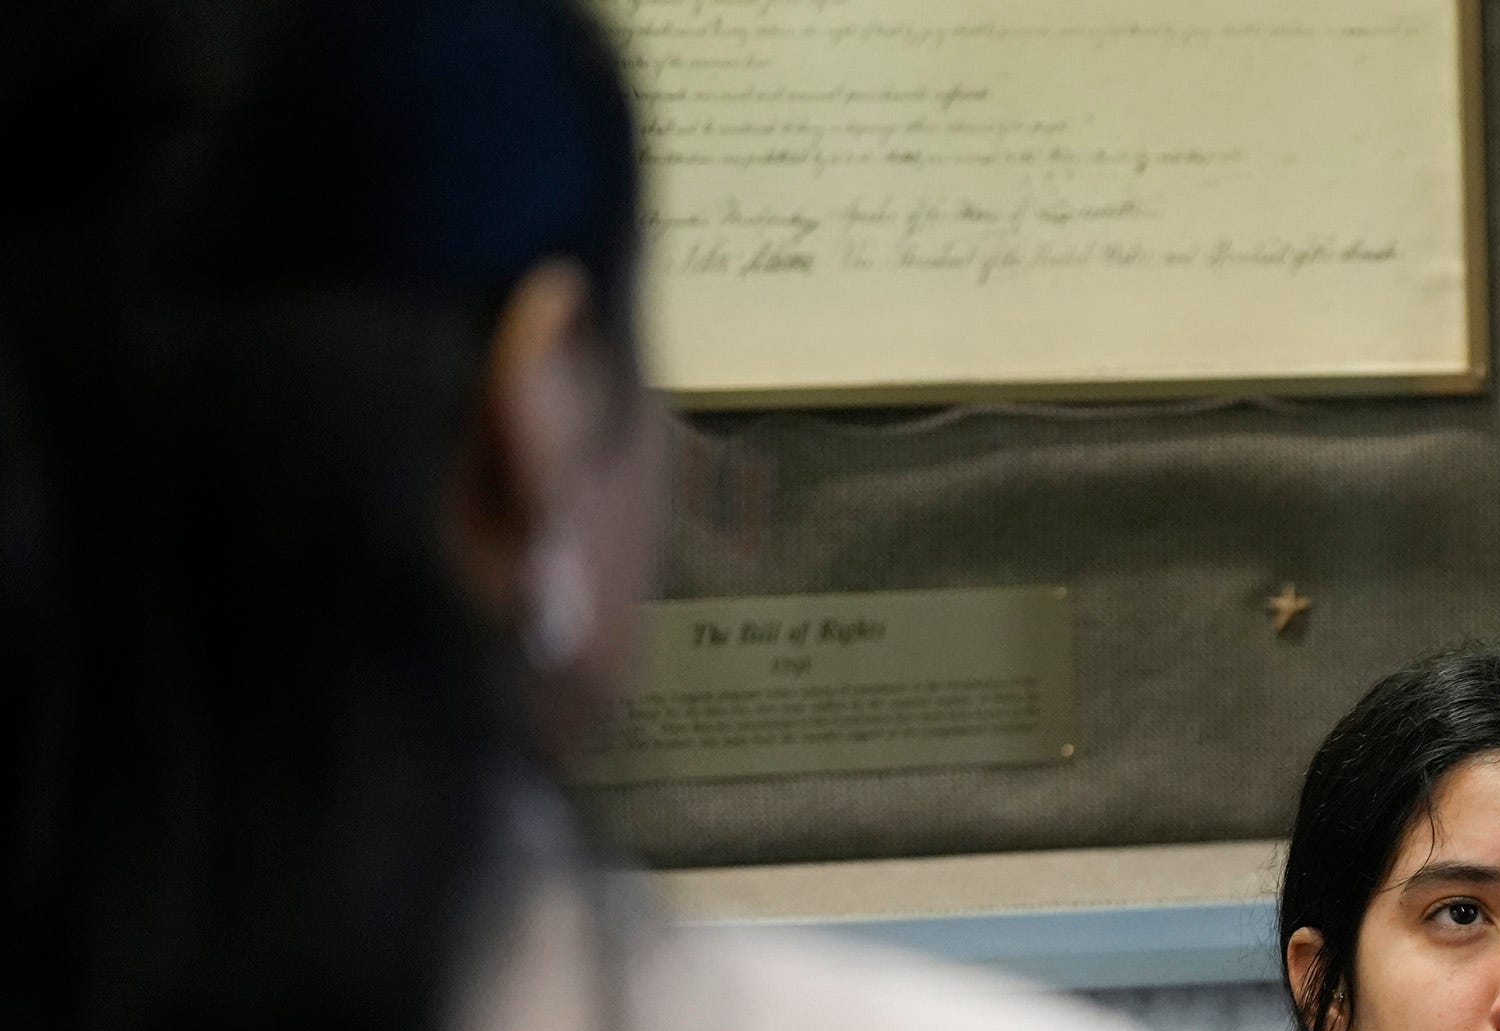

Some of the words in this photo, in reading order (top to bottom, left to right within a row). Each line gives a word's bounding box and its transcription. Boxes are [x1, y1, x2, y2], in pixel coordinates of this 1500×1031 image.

[692, 620, 729, 646] The
[738, 618, 783, 645] Bill
[788, 619, 812, 647] of
[819, 615, 887, 646] Rights
